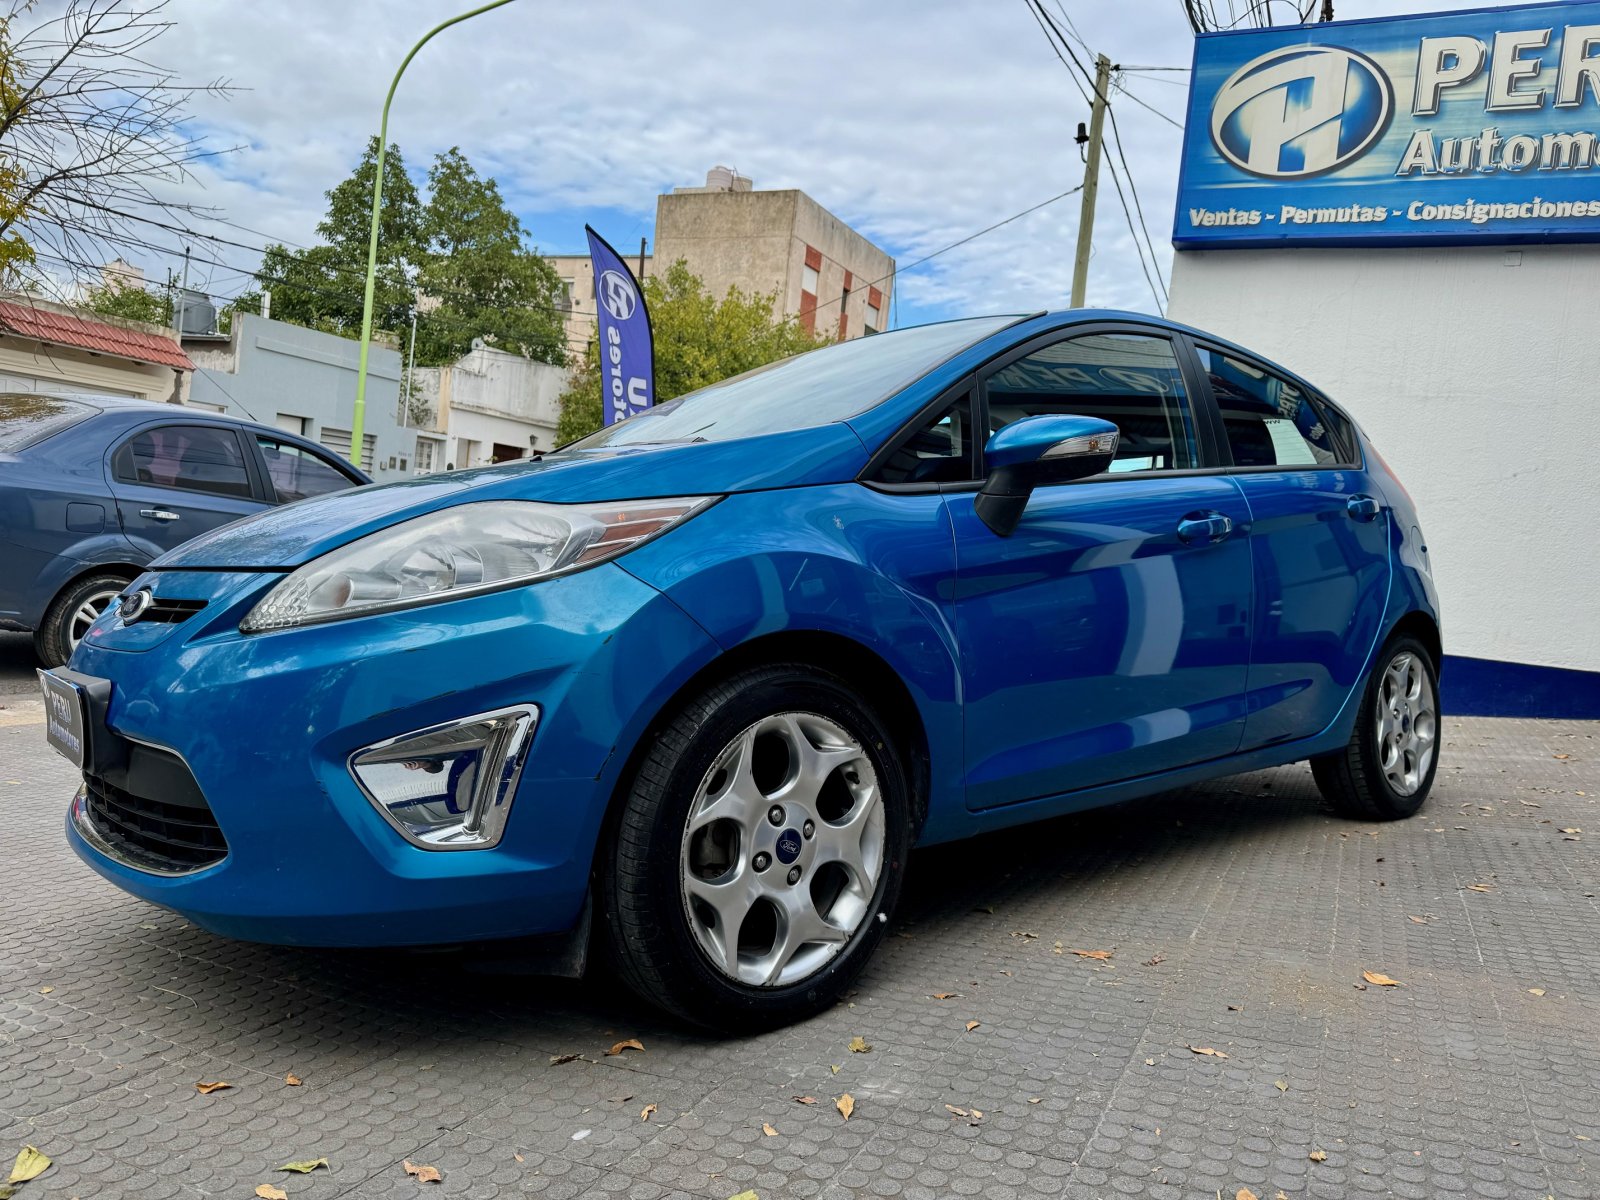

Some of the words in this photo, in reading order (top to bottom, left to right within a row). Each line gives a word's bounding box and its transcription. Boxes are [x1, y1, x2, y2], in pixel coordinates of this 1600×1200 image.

[1411, 25, 1600, 117] PER
[1395, 127, 1600, 177] Autom
[1189, 207, 1262, 227] Ventas
[1279, 204, 1388, 225] Permutas
[1407, 196, 1600, 224] Consignaciones
